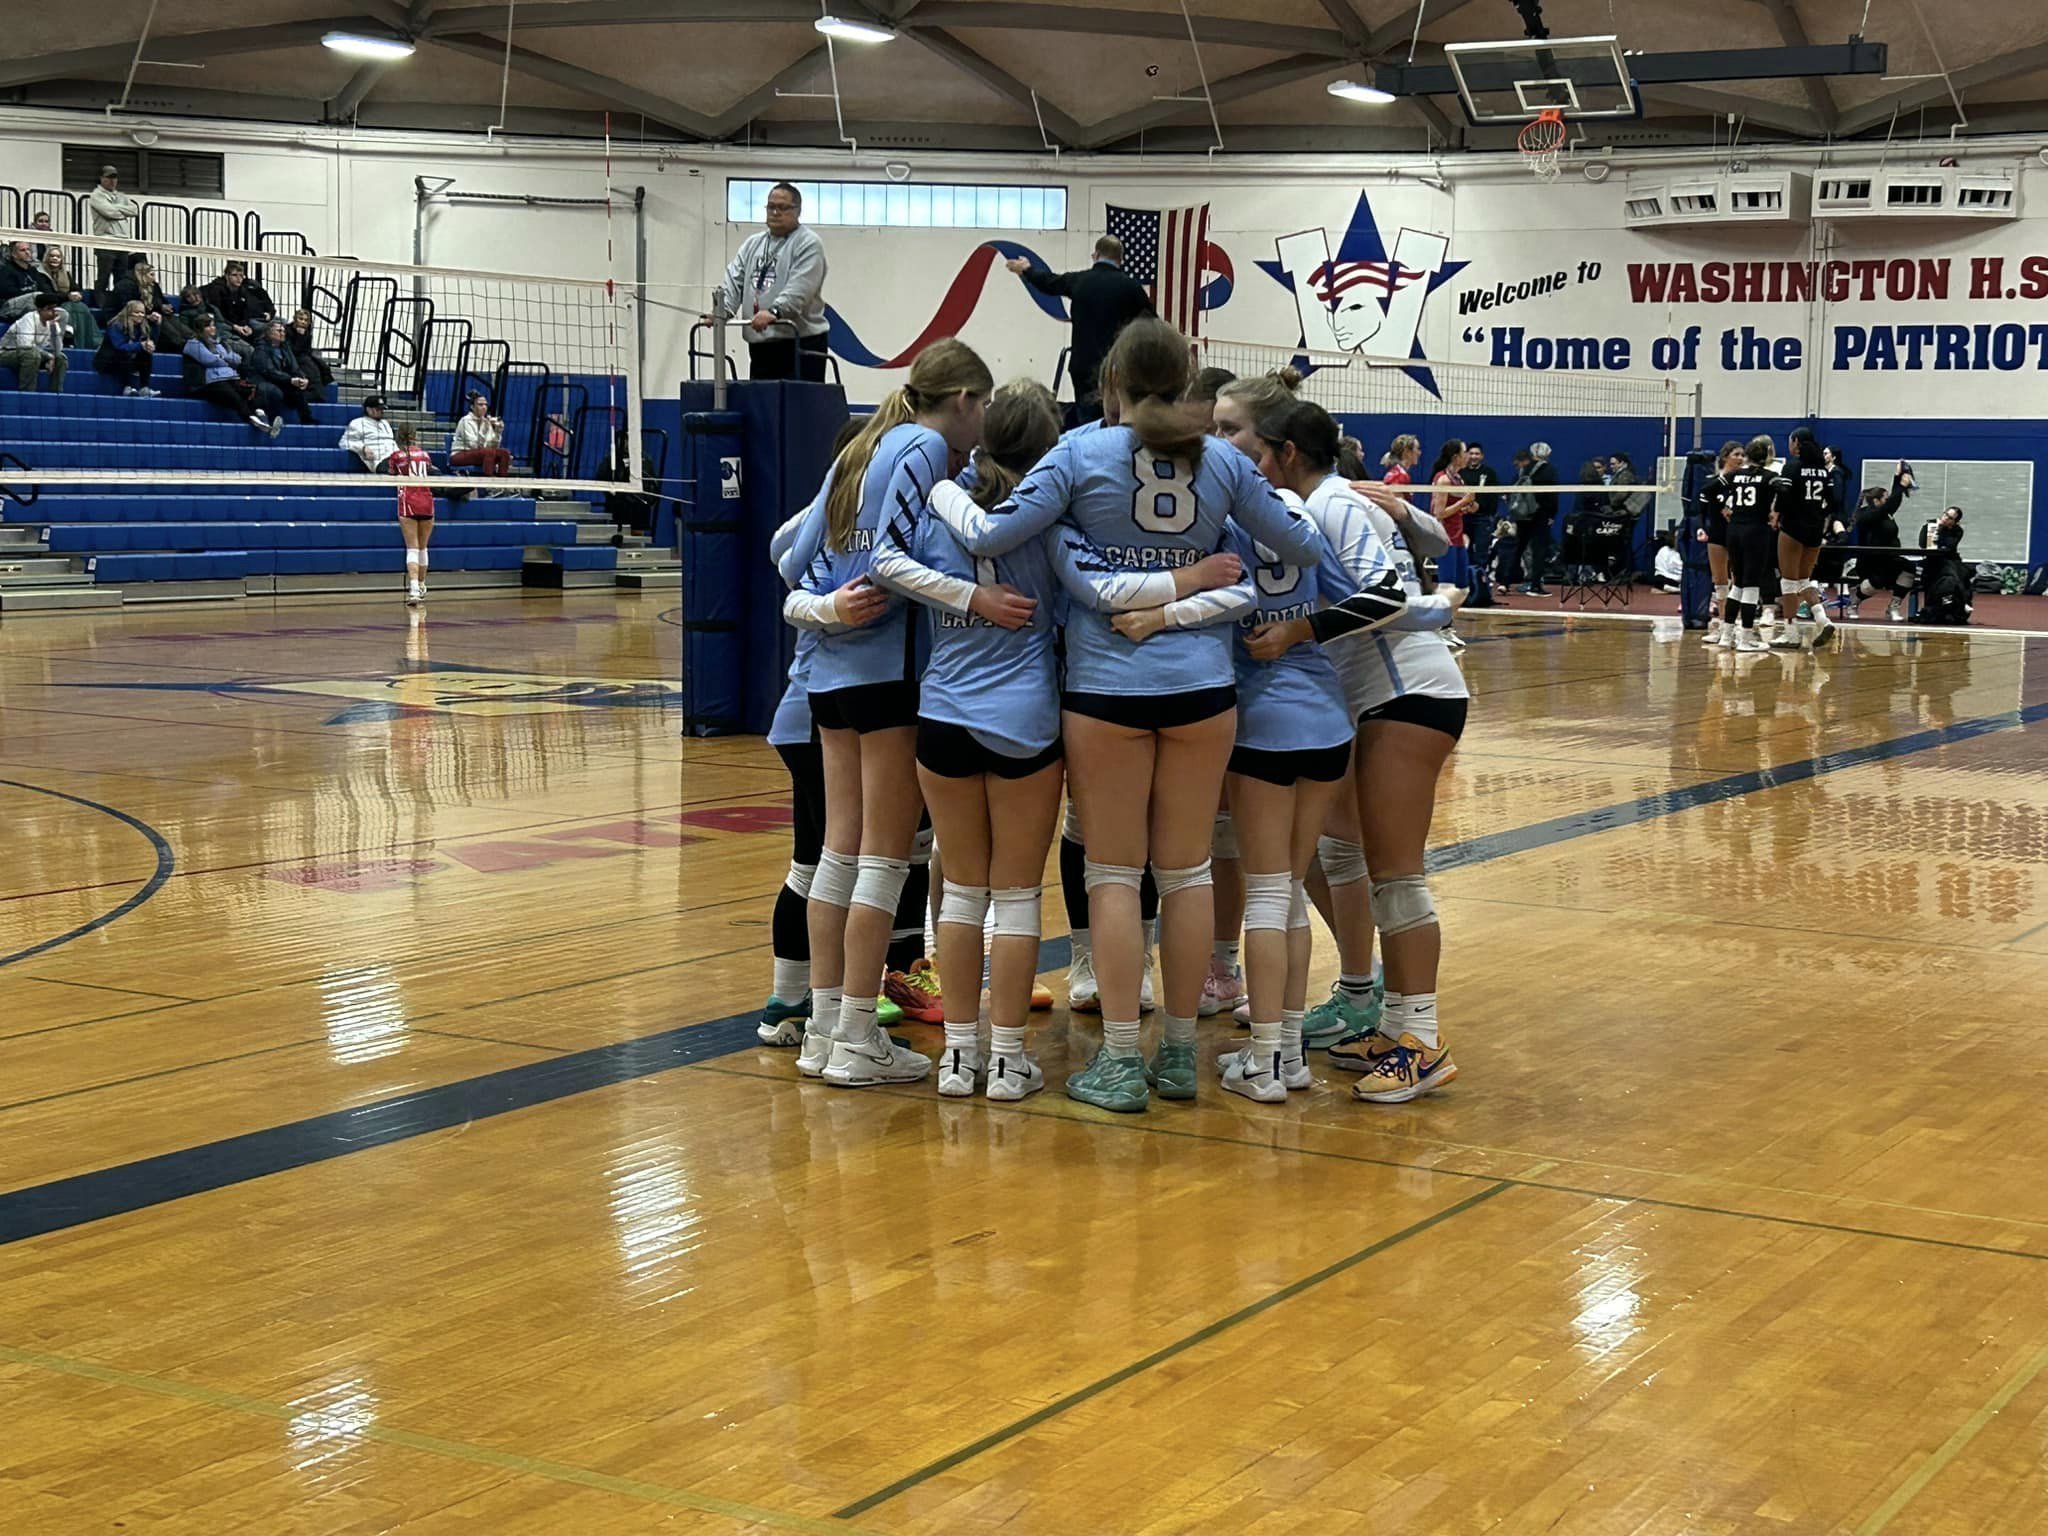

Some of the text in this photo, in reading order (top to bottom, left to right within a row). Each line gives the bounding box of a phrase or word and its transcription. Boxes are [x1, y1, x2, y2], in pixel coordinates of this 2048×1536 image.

[1458, 271, 1568, 316] Welcome
[1577, 261, 1602, 284] to
[1626, 258, 1951, 303] WASHINGTON
[1652, 325, 1702, 370] of
[1720, 325, 1802, 371] the
[1132, 446, 1198, 535] 8
[1735, 486, 1757, 506] 13
[1805, 479, 1824, 501] 12
